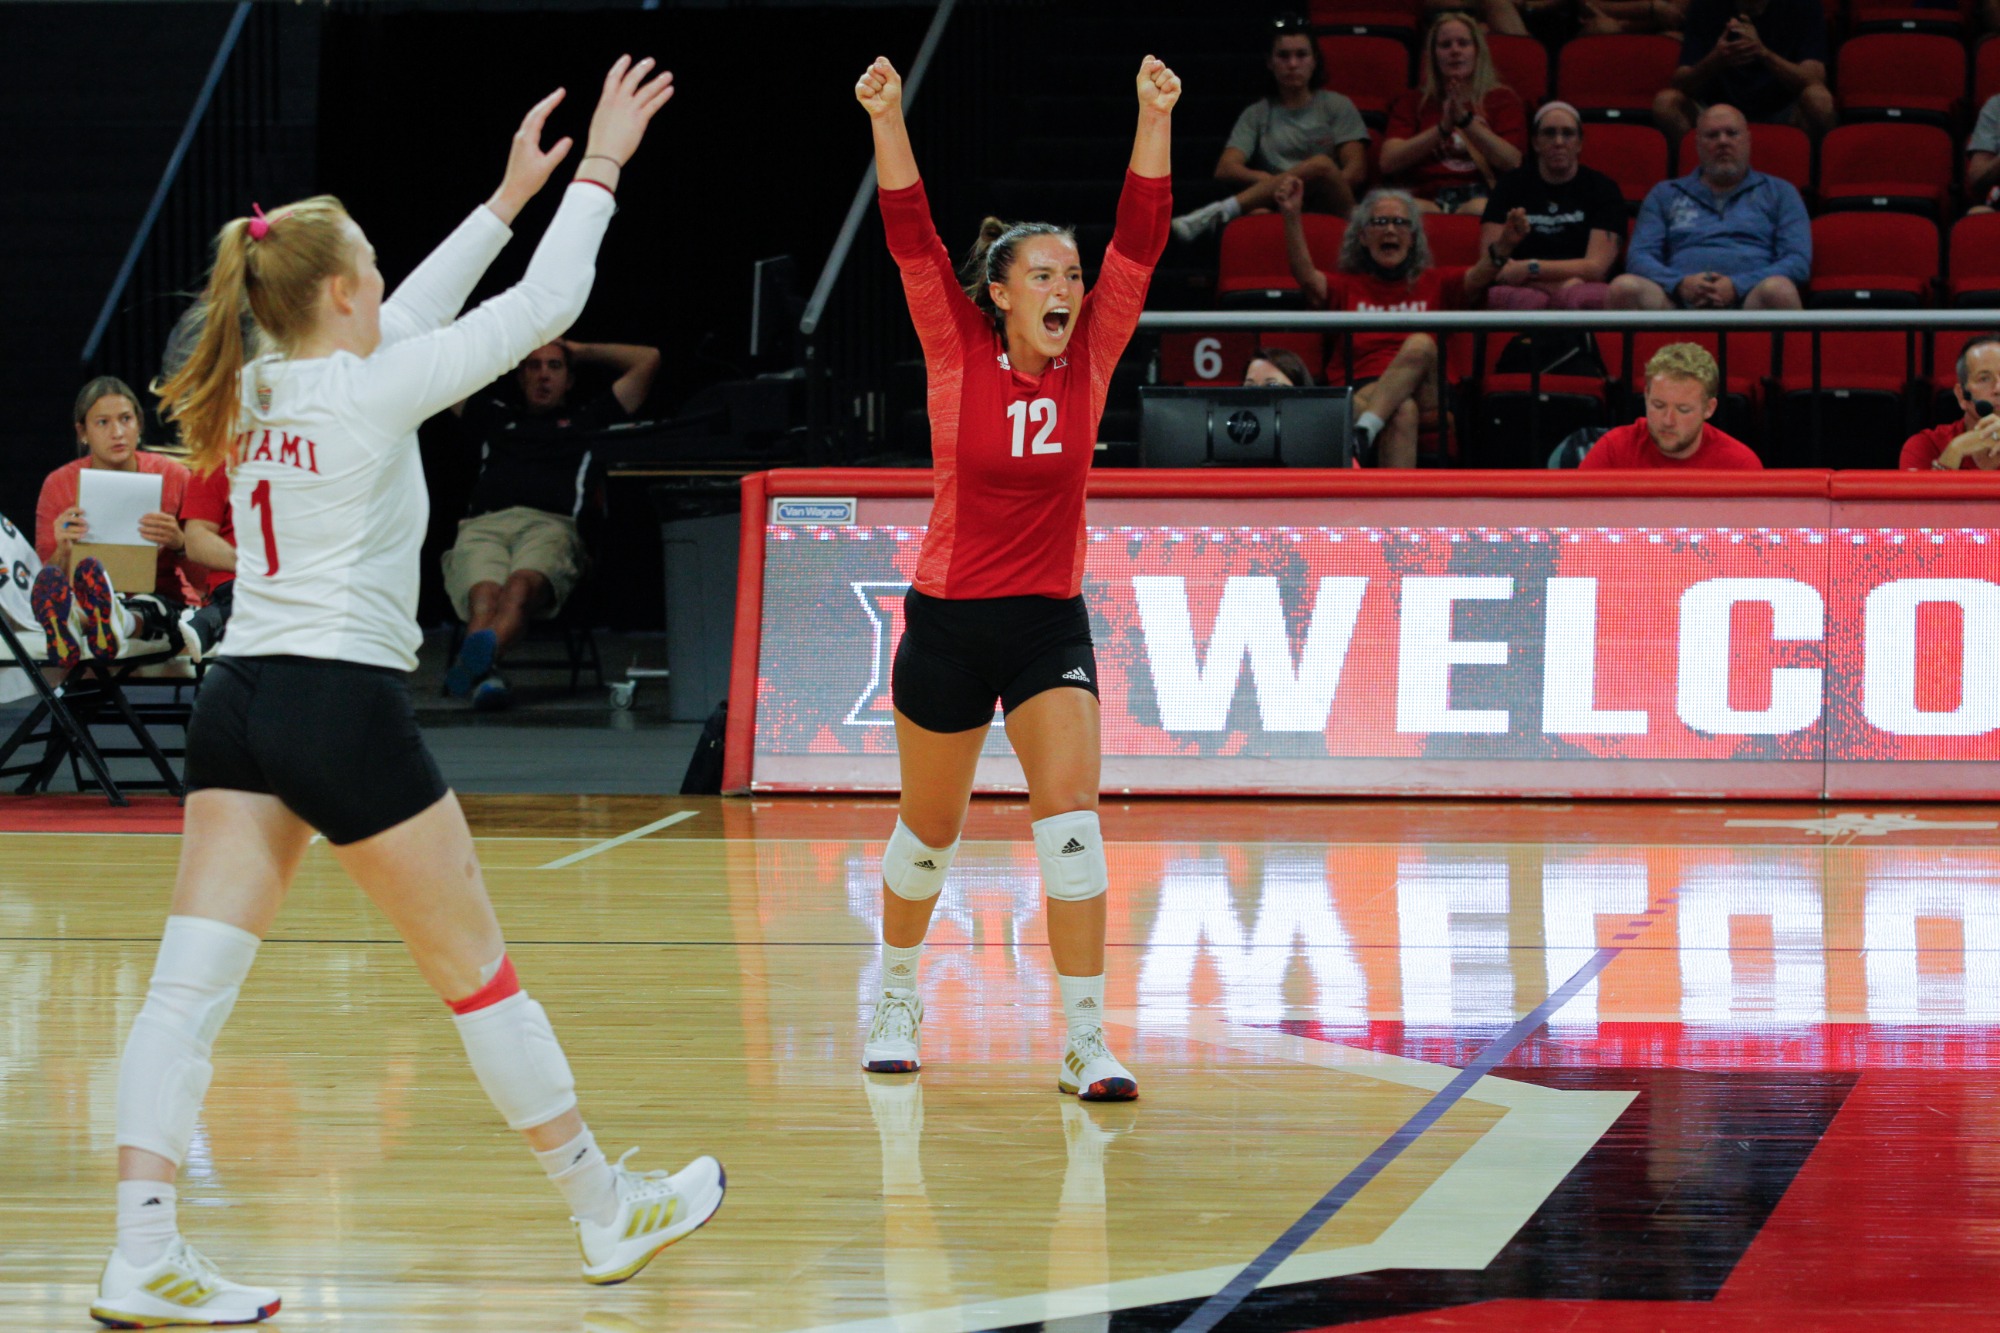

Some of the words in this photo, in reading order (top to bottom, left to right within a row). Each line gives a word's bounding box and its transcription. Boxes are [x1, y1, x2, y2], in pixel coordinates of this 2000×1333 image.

[1193, 337, 1223, 379] 6
[1007, 397, 1063, 458] 12
[234, 429, 321, 476] IAMI
[251, 479, 280, 577] 1
[783, 506, 804, 517] Van
[805, 506, 846, 519] Wagner
[1061, 673, 1090, 683] adidas
[1132, 575, 2000, 736] WELCO
